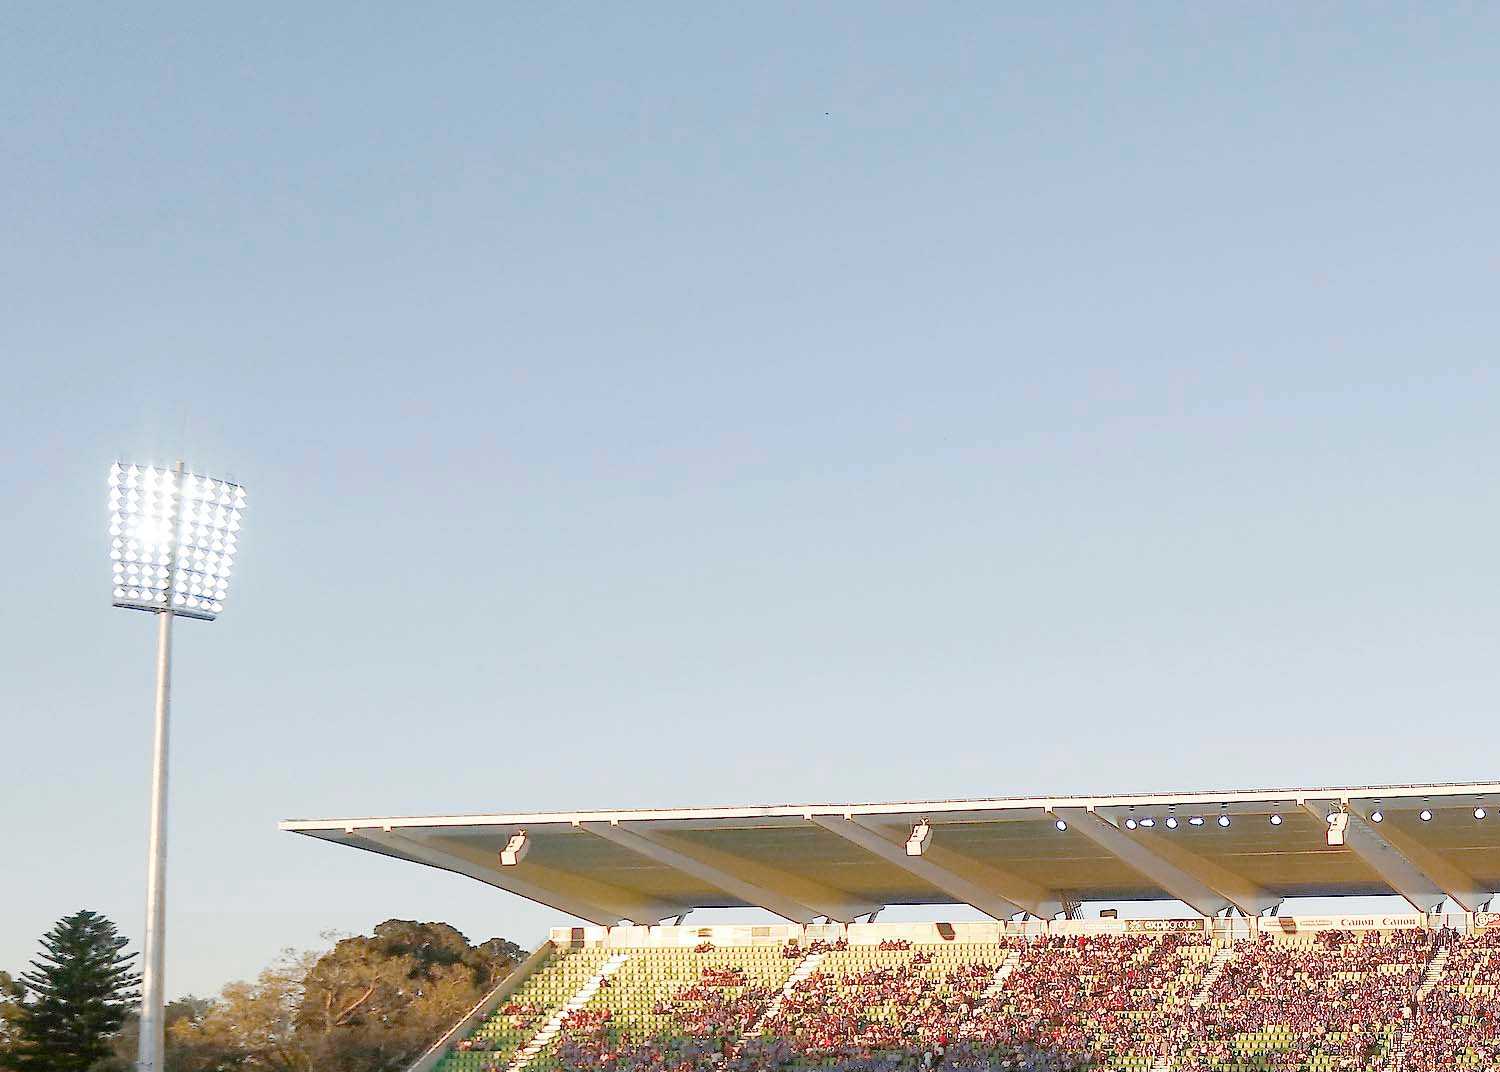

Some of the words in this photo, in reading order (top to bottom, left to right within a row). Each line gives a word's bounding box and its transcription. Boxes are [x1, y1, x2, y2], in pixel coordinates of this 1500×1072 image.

[1145, 919, 1197, 930] expogroup
[1341, 918, 1374, 927] Canon
[1382, 918, 1416, 927] Canon
